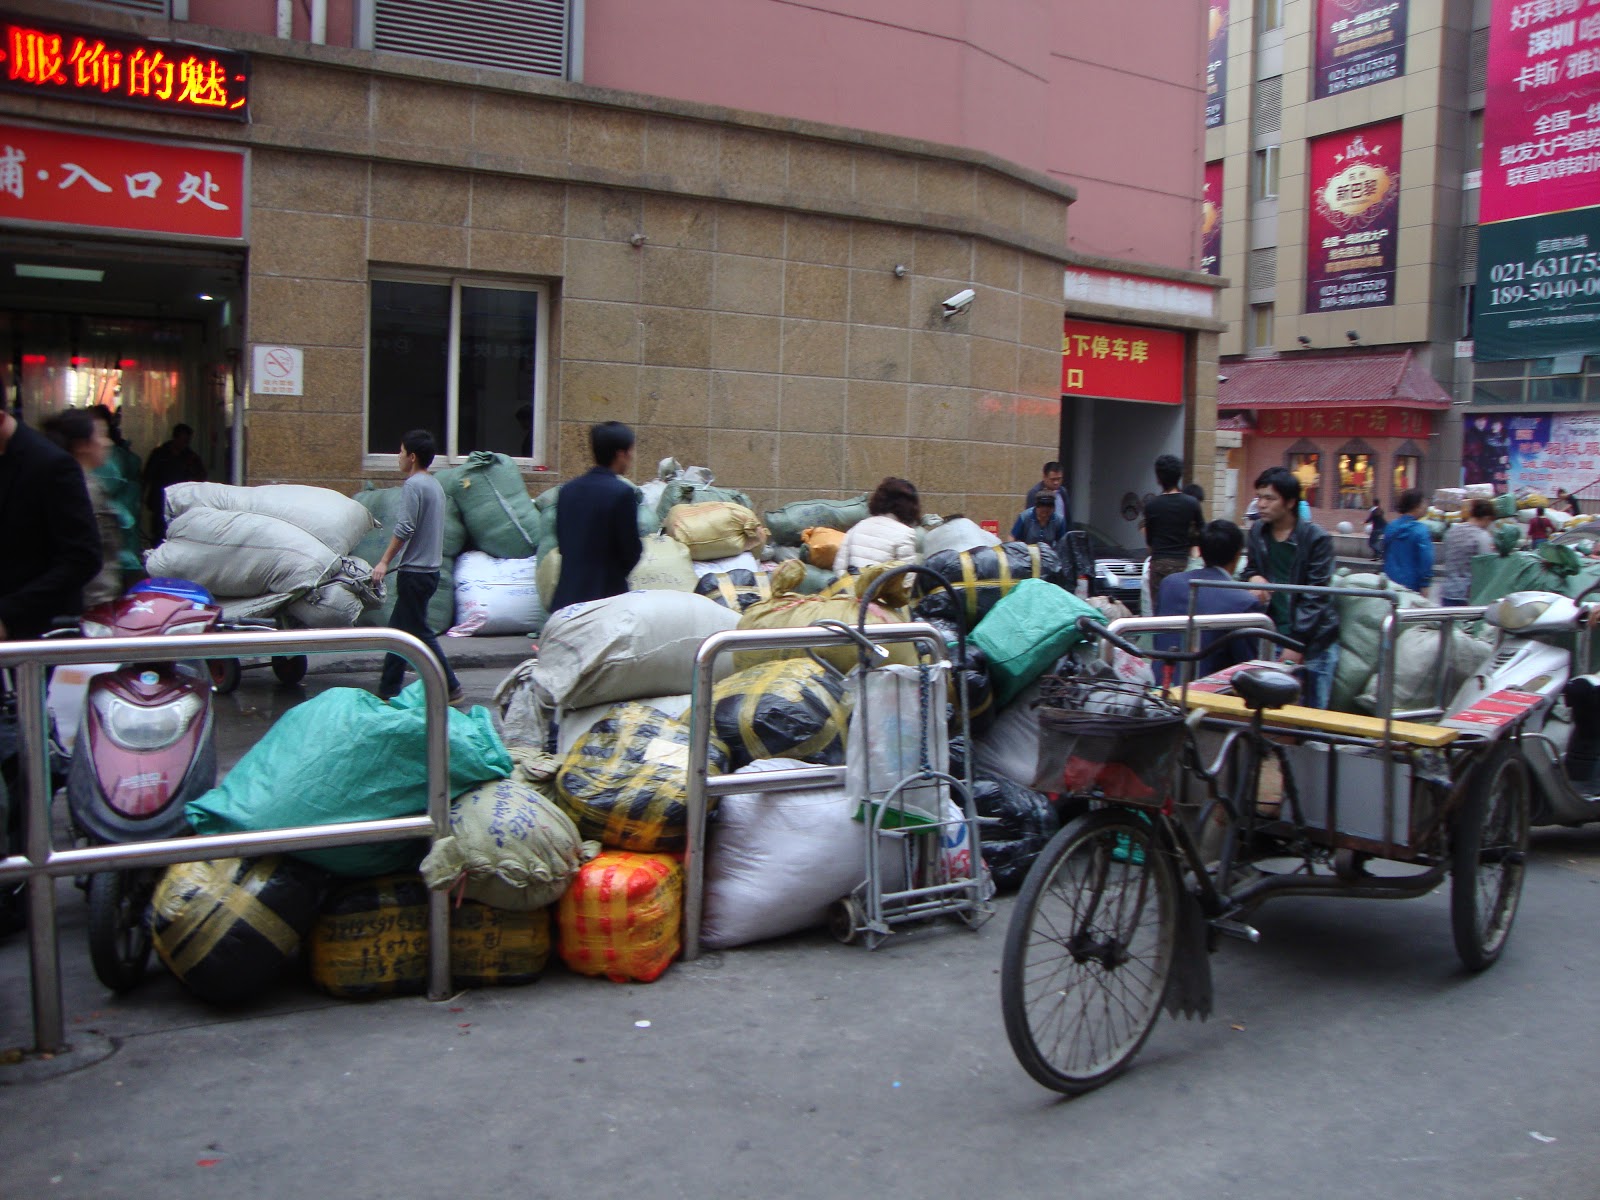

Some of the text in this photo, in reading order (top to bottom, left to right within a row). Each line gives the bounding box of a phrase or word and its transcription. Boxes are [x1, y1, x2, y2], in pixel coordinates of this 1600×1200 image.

[8, 26, 246, 109] 服饰的魅
[1067, 368, 1084, 389] 口
